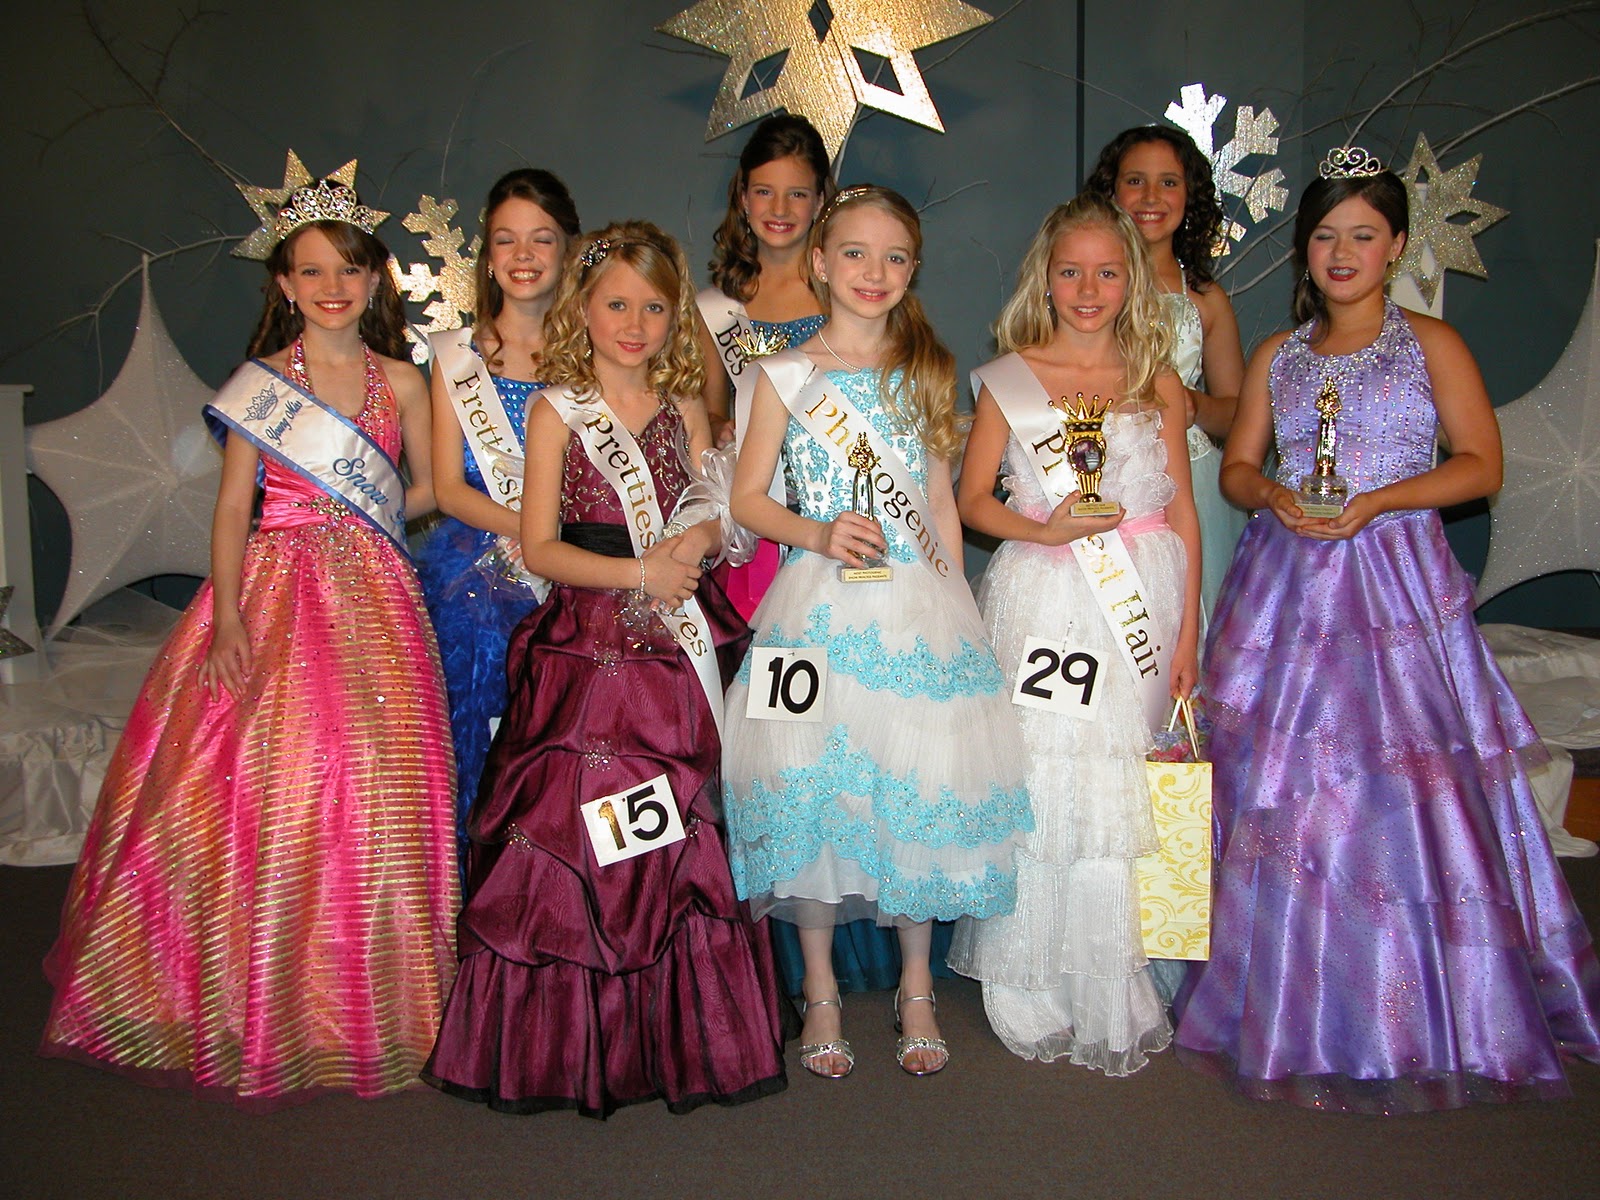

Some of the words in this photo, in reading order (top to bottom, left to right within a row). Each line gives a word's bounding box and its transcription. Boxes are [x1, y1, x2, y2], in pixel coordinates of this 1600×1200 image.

[715, 320, 748, 375] Bes
[265, 417, 292, 446] Young
[285, 400, 303, 420] Miss
[453, 371, 522, 511] Prettst
[333, 458, 389, 505] Snow
[805, 393, 949, 578] Phogenic
[582, 411, 657, 550] Pretties
[659, 607, 707, 657] yes
[1031, 429, 1125, 589] Prest
[1111, 590, 1161, 679] Hair
[768, 657, 819, 714] 10
[1020, 647, 1099, 706] 29
[598, 785, 669, 851] 15
